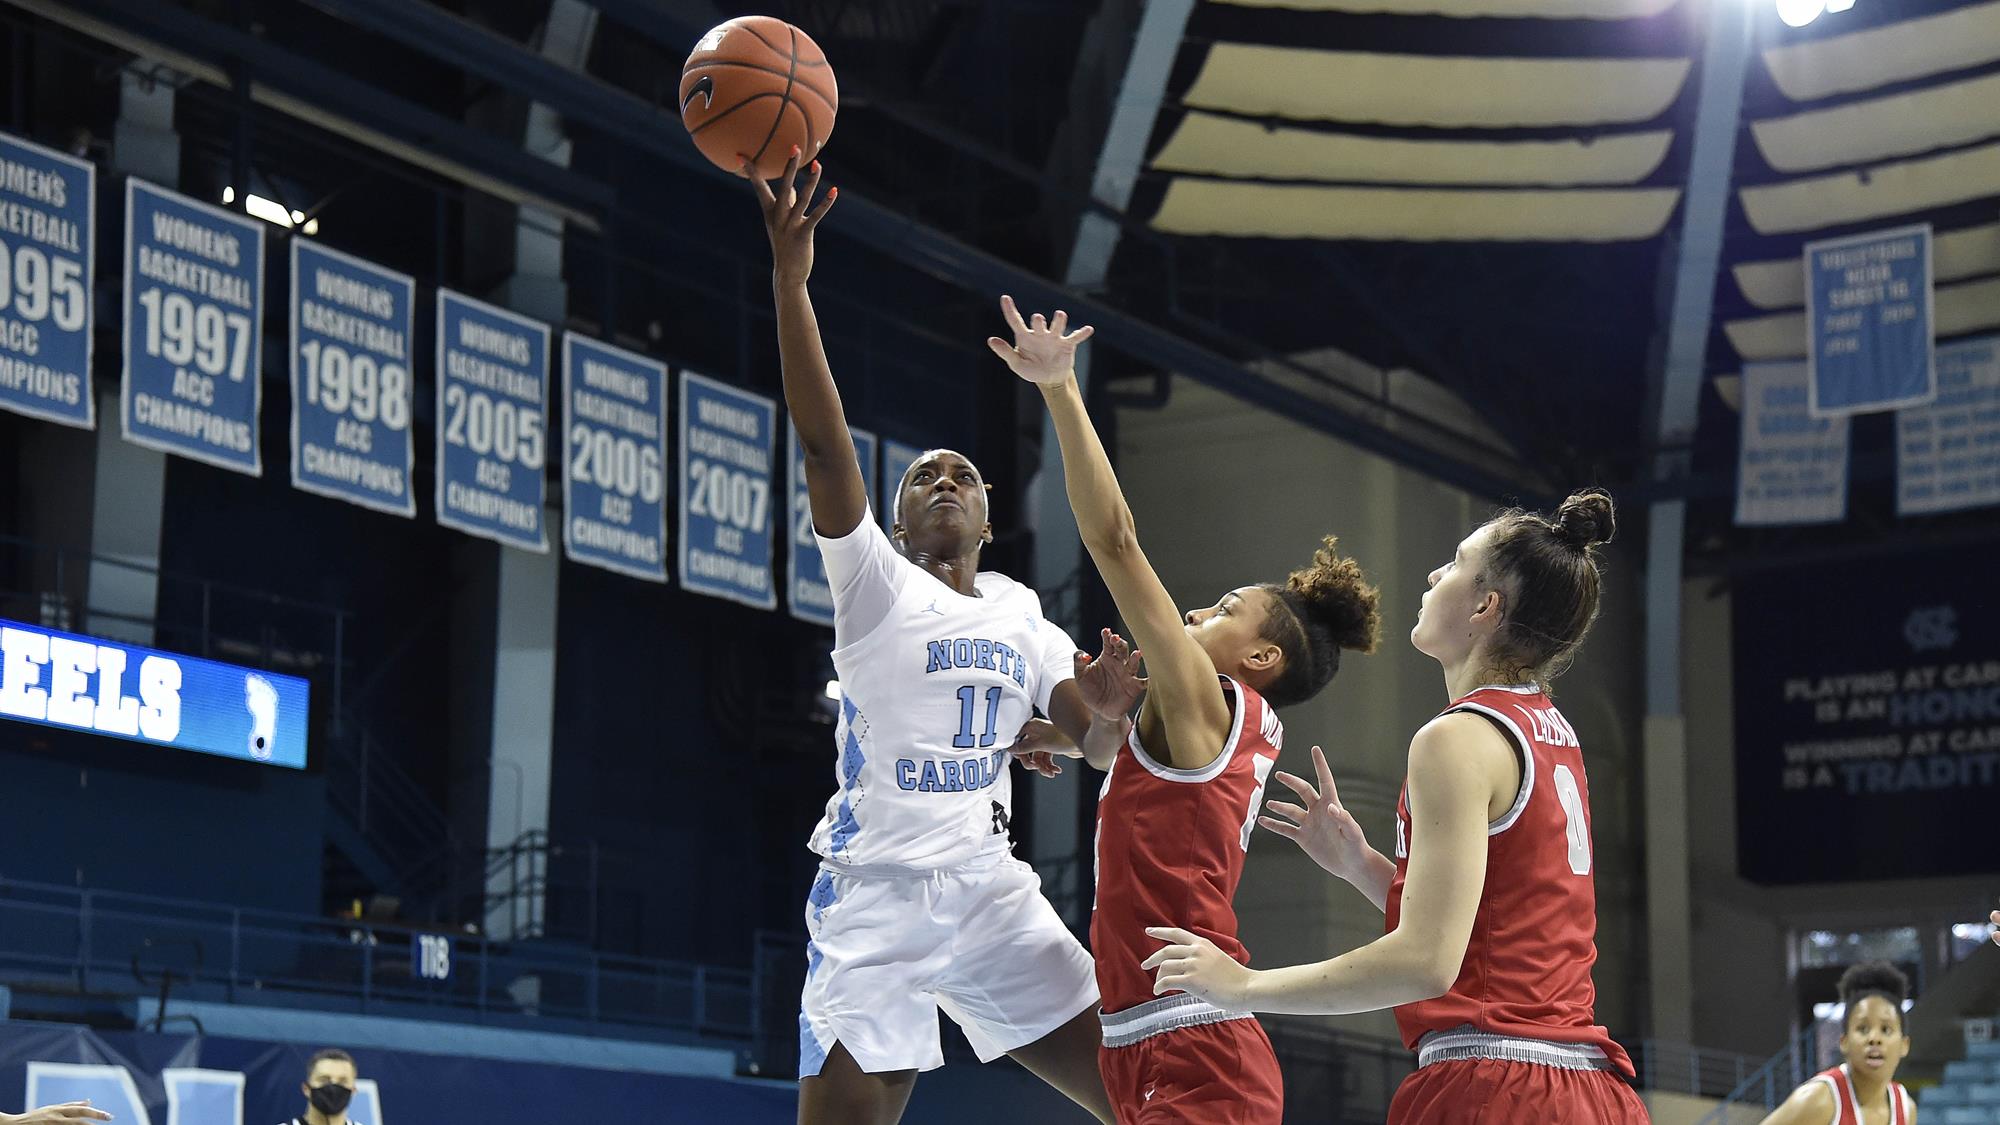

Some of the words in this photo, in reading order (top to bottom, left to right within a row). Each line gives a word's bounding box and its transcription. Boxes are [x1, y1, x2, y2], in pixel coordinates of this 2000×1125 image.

[153, 211, 240, 268] WOMEN'S
[139, 245, 251, 308] BASKETBALL
[140, 287, 250, 382] 1997
[302, 300, 404, 360] BASKETBALL
[172, 368, 214, 406] ACC
[301, 339, 409, 430] 1998
[135, 392, 250, 452] CHAMPIONS
[335, 418, 372, 453] ACC
[446, 384, 544, 470] 2005
[302, 443, 403, 497] CHAMPIONS
[476, 458, 511, 493] ACC
[572, 423, 660, 503] 2006
[448, 480, 538, 531] CHAMPIONS
[601, 494, 632, 524] ACC
[689, 460, 769, 533] 2007
[0, 626, 182, 742] EELS
[926, 638, 1026, 688] NORTH
[1785, 671, 1896, 700] PLAYING
[1903, 666, 1937, 688] AT
[953, 685, 1002, 748] 11
[1847, 697, 1886, 720] AN
[1908, 731, 1941, 754] AT
[1813, 766, 1834, 786] A
[1553, 764, 1591, 876] 0
